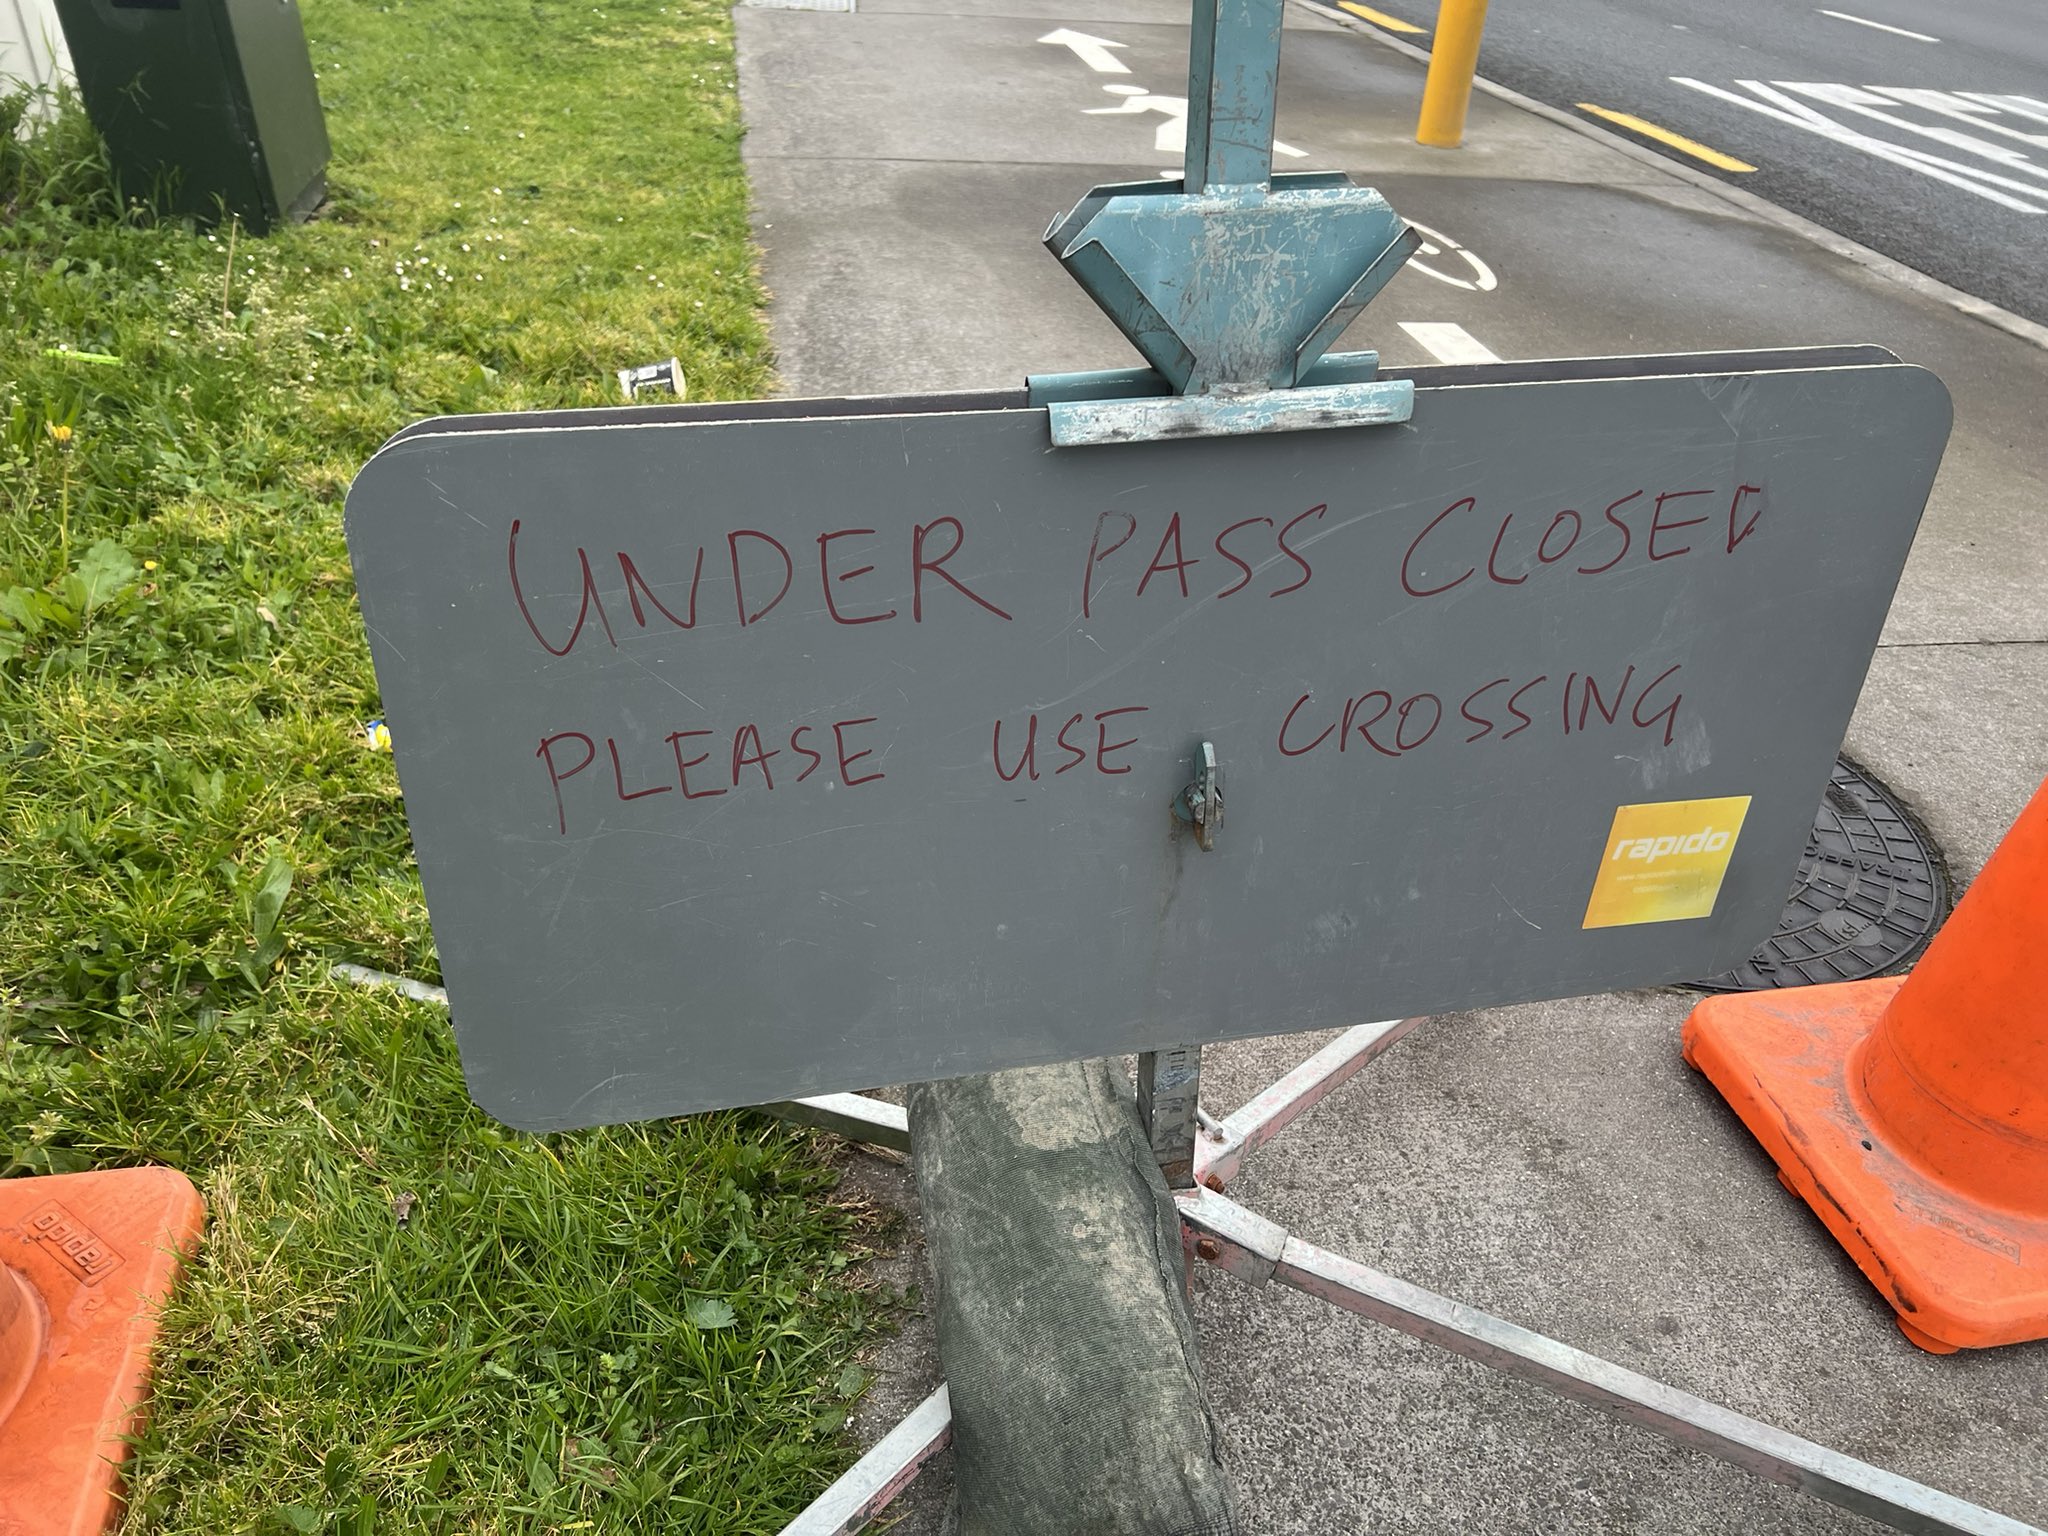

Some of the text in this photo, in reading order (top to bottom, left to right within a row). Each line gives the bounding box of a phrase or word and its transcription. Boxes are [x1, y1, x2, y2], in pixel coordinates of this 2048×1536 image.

[509, 484, 1763, 657] UNDER PASS CLOSED
[536, 664, 1683, 835] PLEASE USE CROSSING
[1612, 826, 1731, 864] rapido
[32, 1211, 112, 1275] rapido
